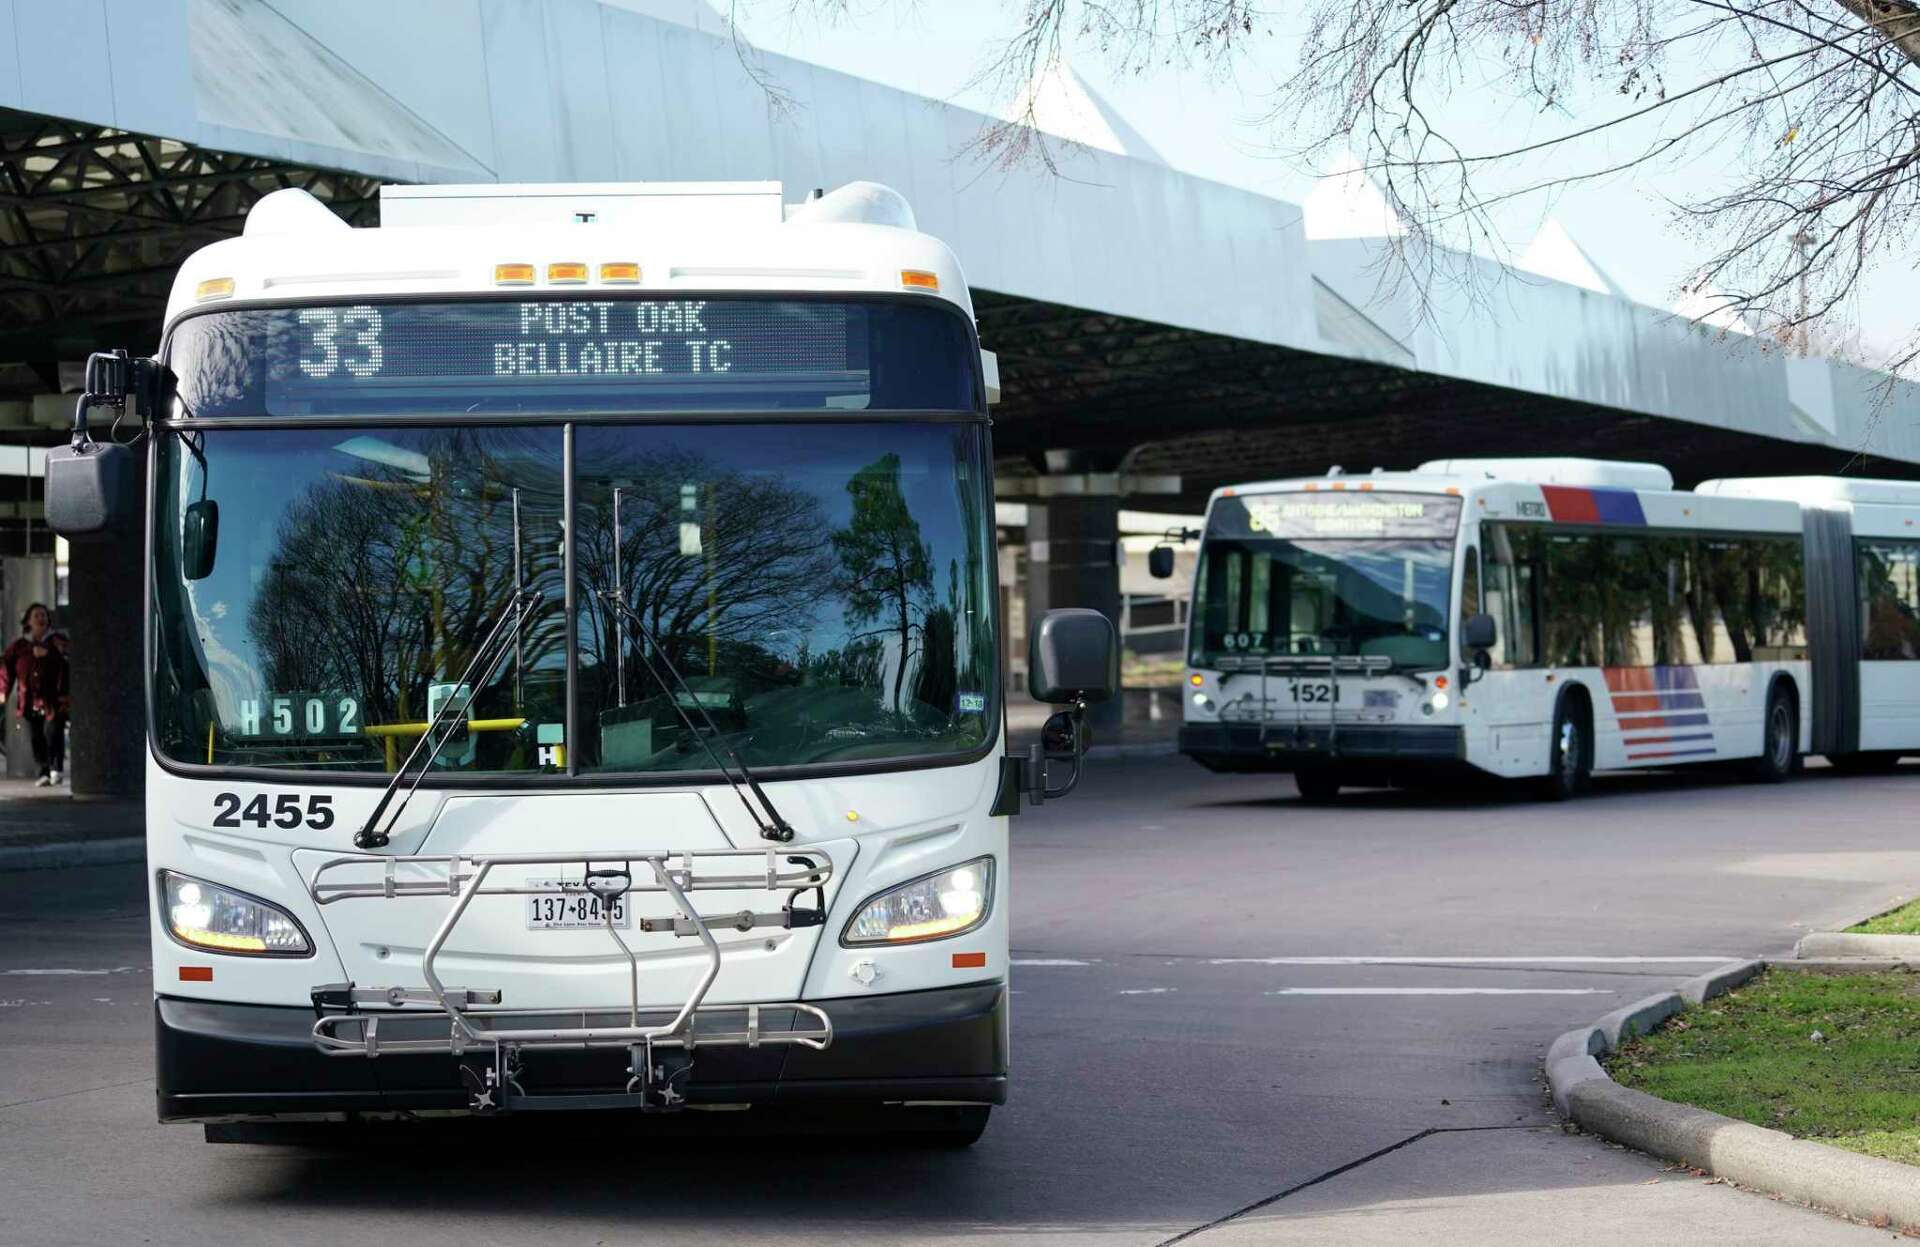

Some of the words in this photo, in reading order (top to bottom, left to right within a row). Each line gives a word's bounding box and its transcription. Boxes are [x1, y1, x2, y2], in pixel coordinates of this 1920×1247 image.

[520, 303, 612, 333] POST
[637, 302, 707, 333] OAK
[299, 306, 383, 377] 33
[494, 342, 662, 376] BELLAIRE
[686, 341, 732, 374] TC
[1224, 634, 1263, 647] 607
[1289, 684, 1340, 703] 1521
[241, 698, 358, 735] H502
[213, 792, 335, 830] 2455
